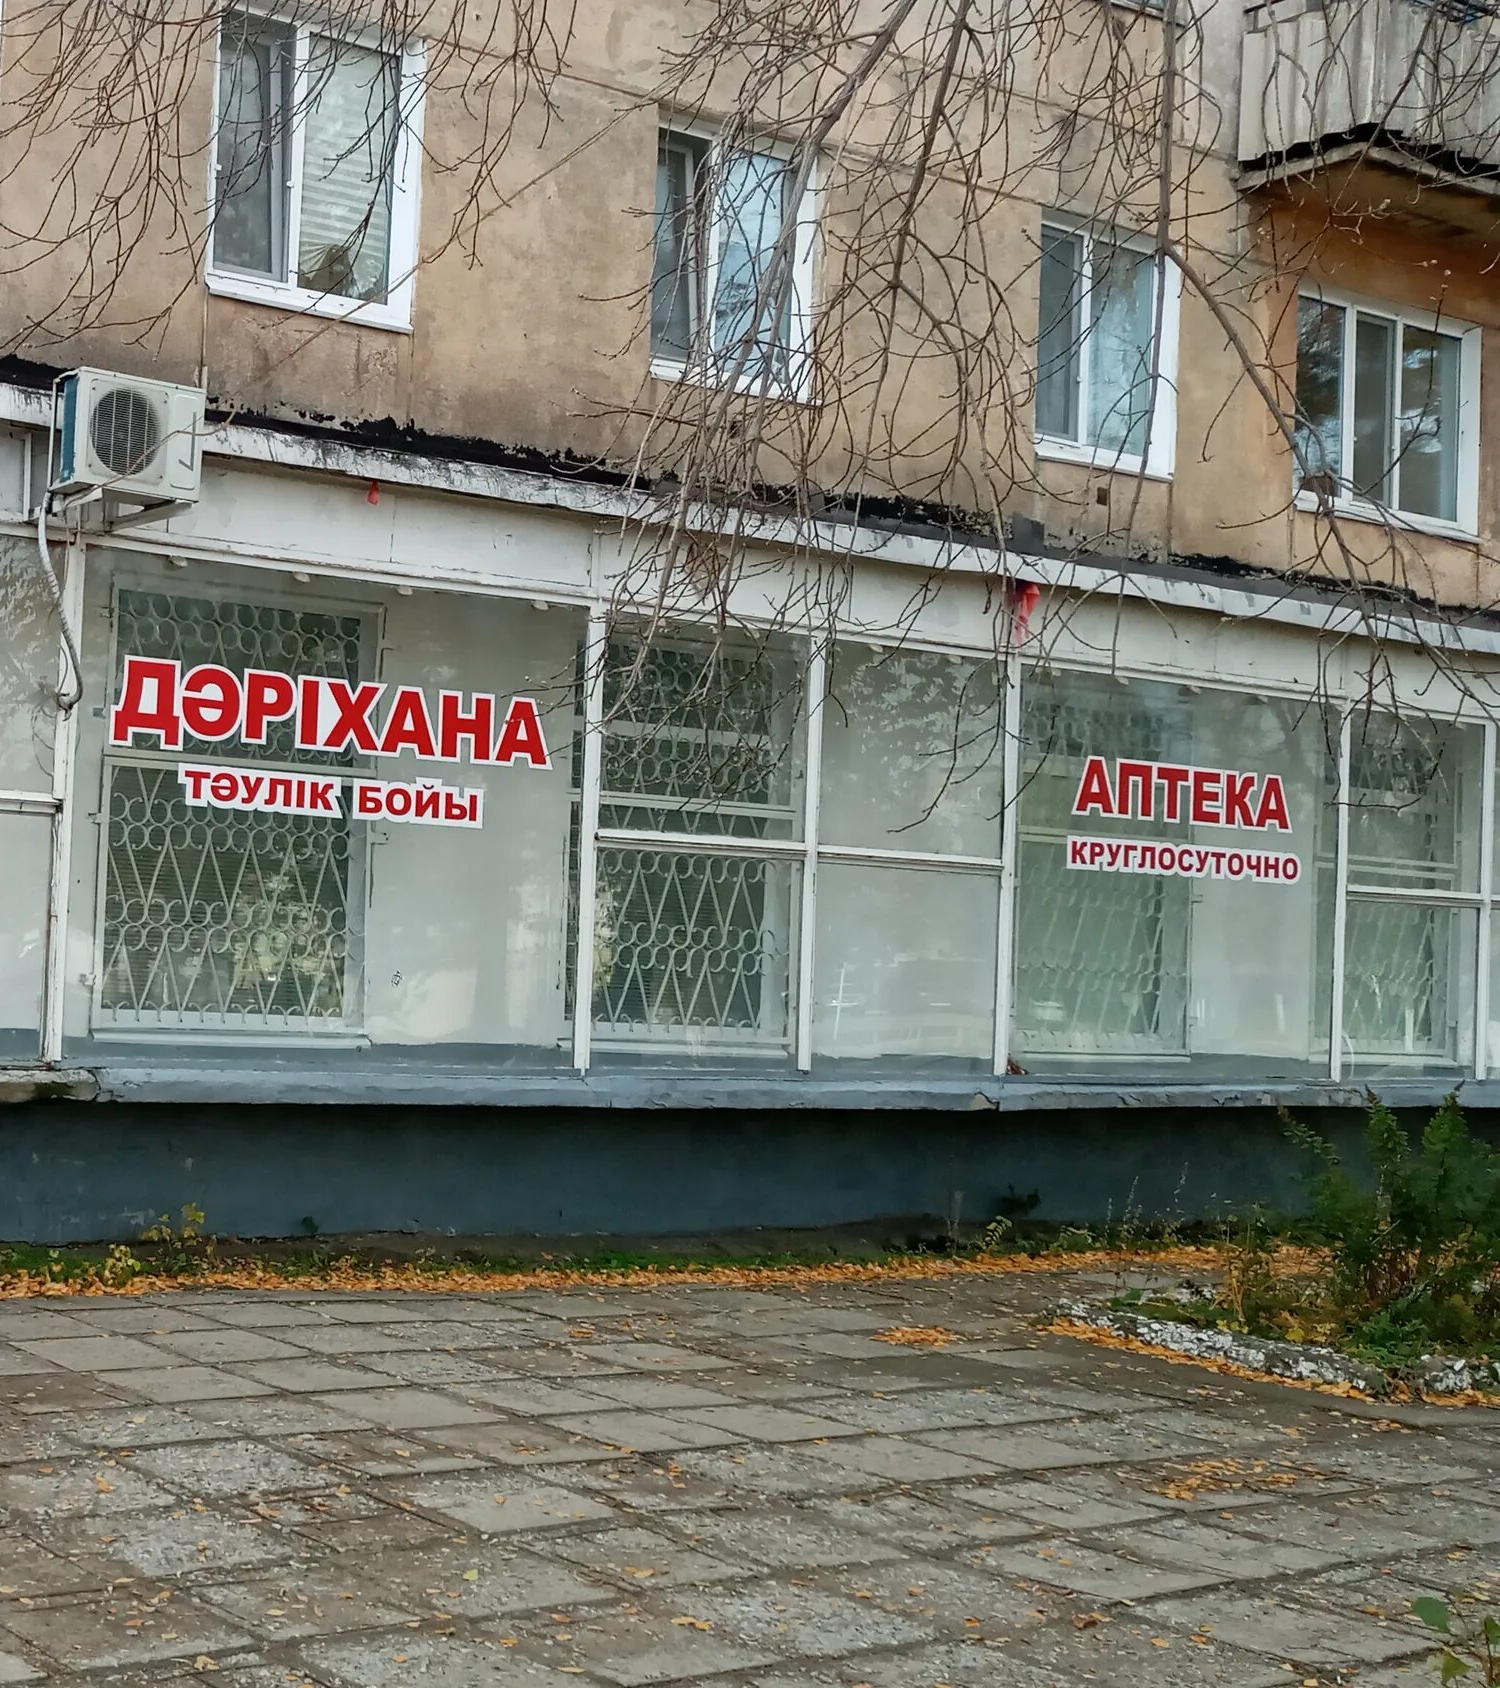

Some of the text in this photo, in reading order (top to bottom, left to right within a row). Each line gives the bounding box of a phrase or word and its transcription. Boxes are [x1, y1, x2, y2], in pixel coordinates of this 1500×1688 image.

[113, 659, 547, 767] ДӘРІХАНА
[358, 784, 479, 822] БОЙЫ
[1075, 758, 1290, 830] АПТЕКА
[1071, 840, 1299, 880] КРУГЛОСУТОЧНО
